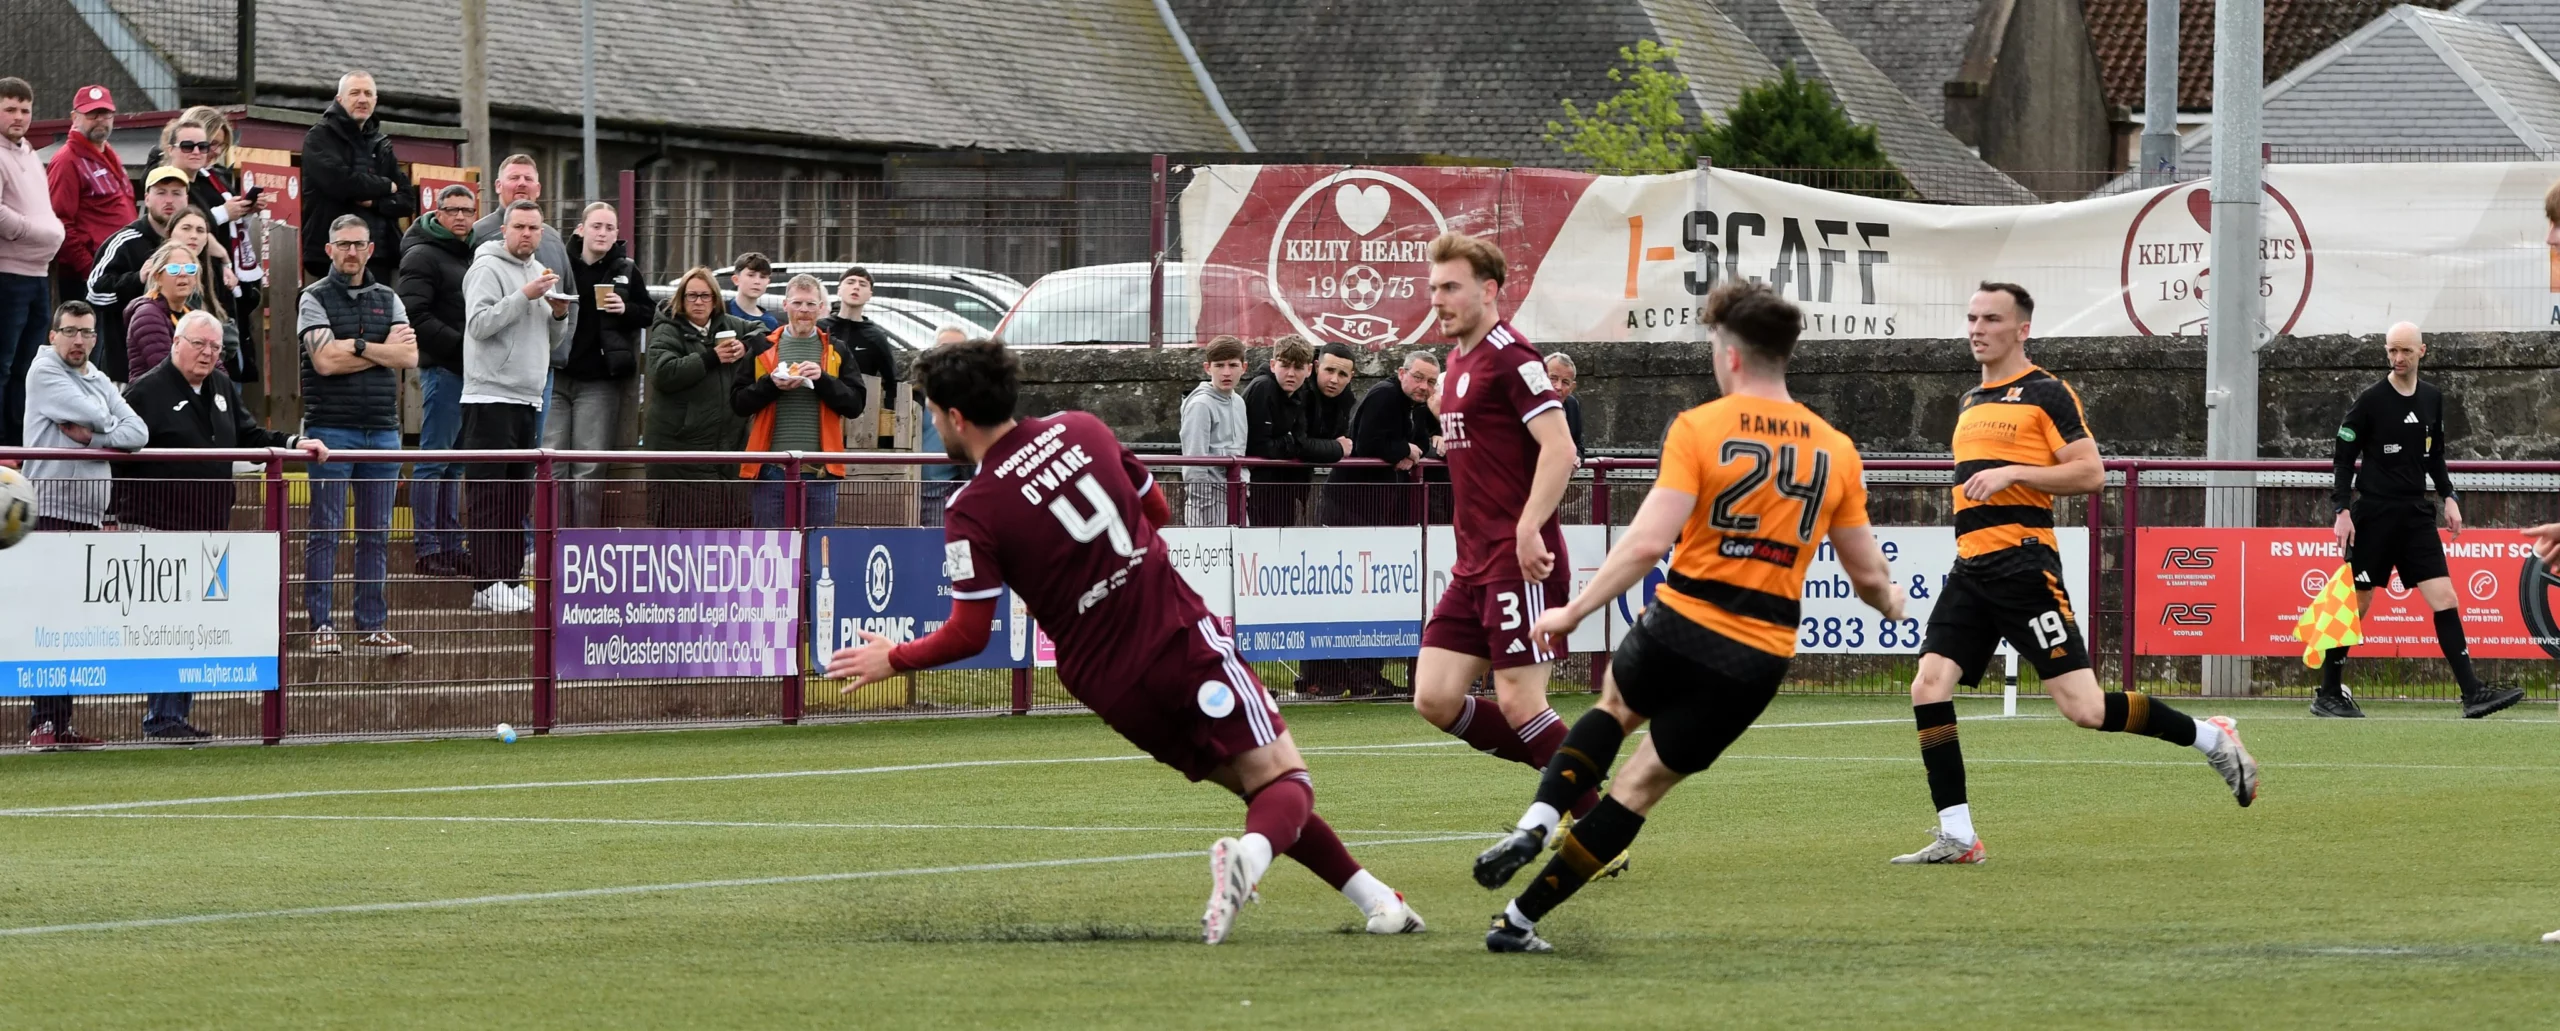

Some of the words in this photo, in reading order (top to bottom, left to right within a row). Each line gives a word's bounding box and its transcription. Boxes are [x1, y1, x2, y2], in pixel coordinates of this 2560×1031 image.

[1286, 240, 1354, 262] KELTY
[2138, 242, 2204, 265] KELTY
[2259, 238, 2296, 260] RTS
[1306, 276, 1337, 299] 19
[1388, 277, 1415, 299] 75
[2158, 279, 2188, 302] 19
[2259, 275, 2273, 298] 5
[1340, 319, 1373, 337] F.C.
[1627, 307, 1703, 329] ACCE
[1740, 413, 1811, 438] RANKIN
[994, 442, 1037, 479] NORTH
[1033, 423, 1067, 447] ROAD
[1015, 437, 1065, 478] GARAGE
[1020, 443, 1093, 506] O'WARE
[1708, 438, 1831, 543] 24
[1048, 472, 1133, 558] 4
[1193, 542, 1233, 575] Agents
[2161, 547, 2219, 570] RS
[2270, 541, 2294, 557] RS
[2296, 541, 2344, 557] WHE
[83, 543, 187, 617] Layher
[563, 544, 793, 594] BASTENSNEDDON
[1237, 550, 1353, 597] Moorelands
[1358, 549, 1419, 595] Travel
[1909, 574, 1930, 599] &
[562, 603, 623, 627] Advocates,
[625, 602, 675, 623] Solicitors
[678, 602, 697, 622] and
[699, 602, 727, 627] Legal
[1496, 591, 1522, 631] 3
[2160, 603, 2217, 625] RS
[34, 627, 60, 648] More
[62, 626, 123, 651] possibilities.
[123, 626, 140, 647] The
[142, 625, 195, 650] Scaffolding
[197, 624, 233, 648] System.
[1237, 632, 1252, 651] Tel:
[1254, 632, 1272, 650] 0800
[1272, 631, 1286, 649] 612
[1286, 630, 1305, 649] 6018
[1310, 629, 1419, 648] www.moorelandstravel.com
[2028, 610, 2068, 650] 19
[2365, 636, 2393, 644] MOBILE
[2394, 636, 2420, 644] WHEEL
[2483, 637, 2500, 645] AND
[2501, 637, 2527, 645] REPAIR
[584, 634, 771, 665] law@bastensneddon.co.uk
[17, 667, 35, 689] Tel:
[36, 667, 67, 688] 01506
[69, 666, 107, 687] 440220
[178, 662, 258, 687] www.layher.co.uk
